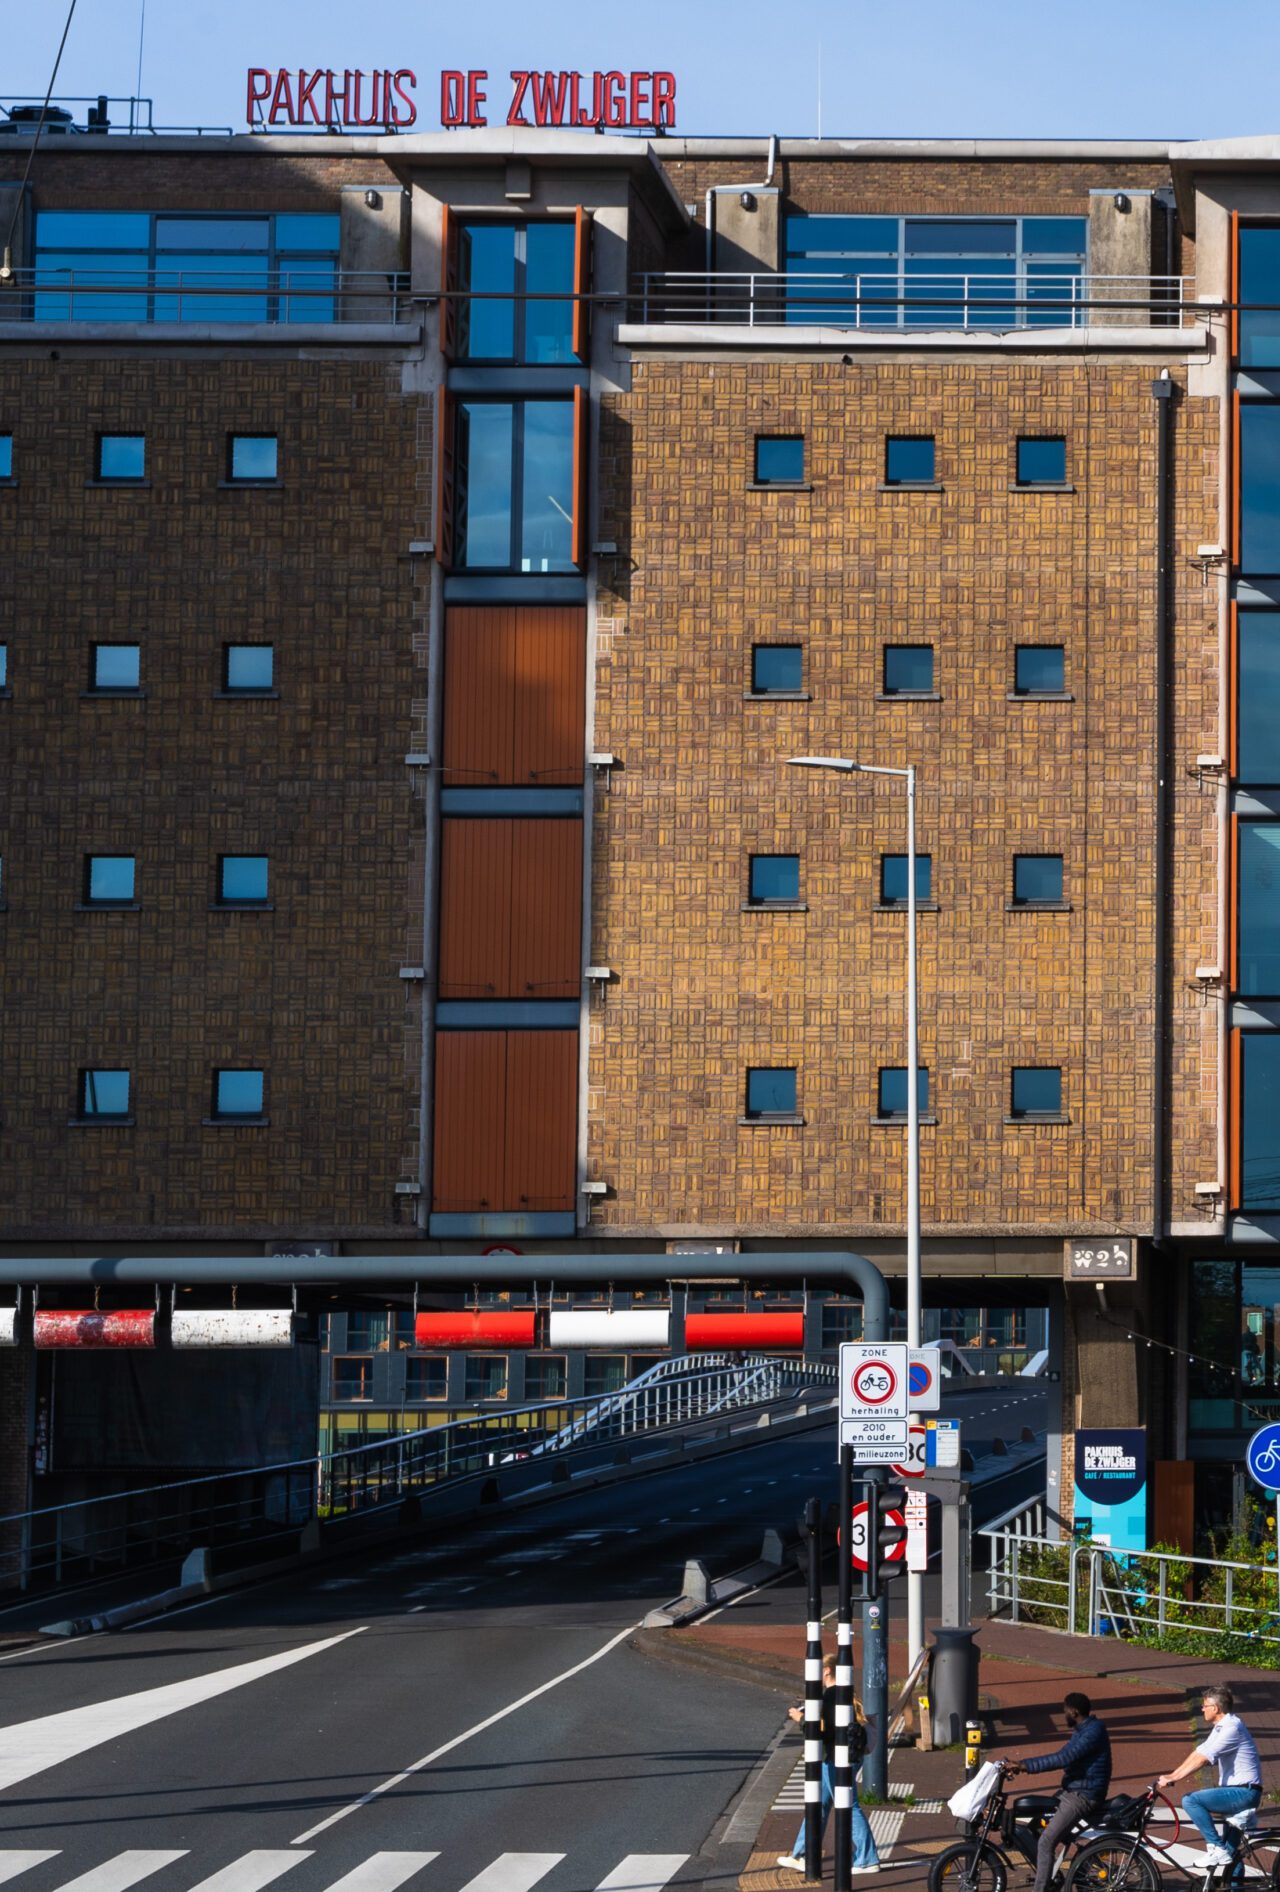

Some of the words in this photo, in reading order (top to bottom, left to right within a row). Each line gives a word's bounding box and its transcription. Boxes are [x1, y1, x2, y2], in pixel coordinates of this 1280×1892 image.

[247, 68, 417, 126] PAKHUIS
[440, 70, 488, 127] DE
[506, 70, 676, 128] ZWIJGER
[861, 1349, 888, 1357] ZONE
[851, 1407, 899, 1416] herhaling
[862, 1423, 886, 1432] 2010
[867, 1433, 896, 1441] ouder
[858, 1450, 904, 1458] milieuzone
[1084, 1446, 1123, 1457] PAKHUIS
[1084, 1456, 1096, 1468] DE
[1097, 1456, 1136, 1468] ZWIJGER
[852, 1523, 865, 1546] 3
